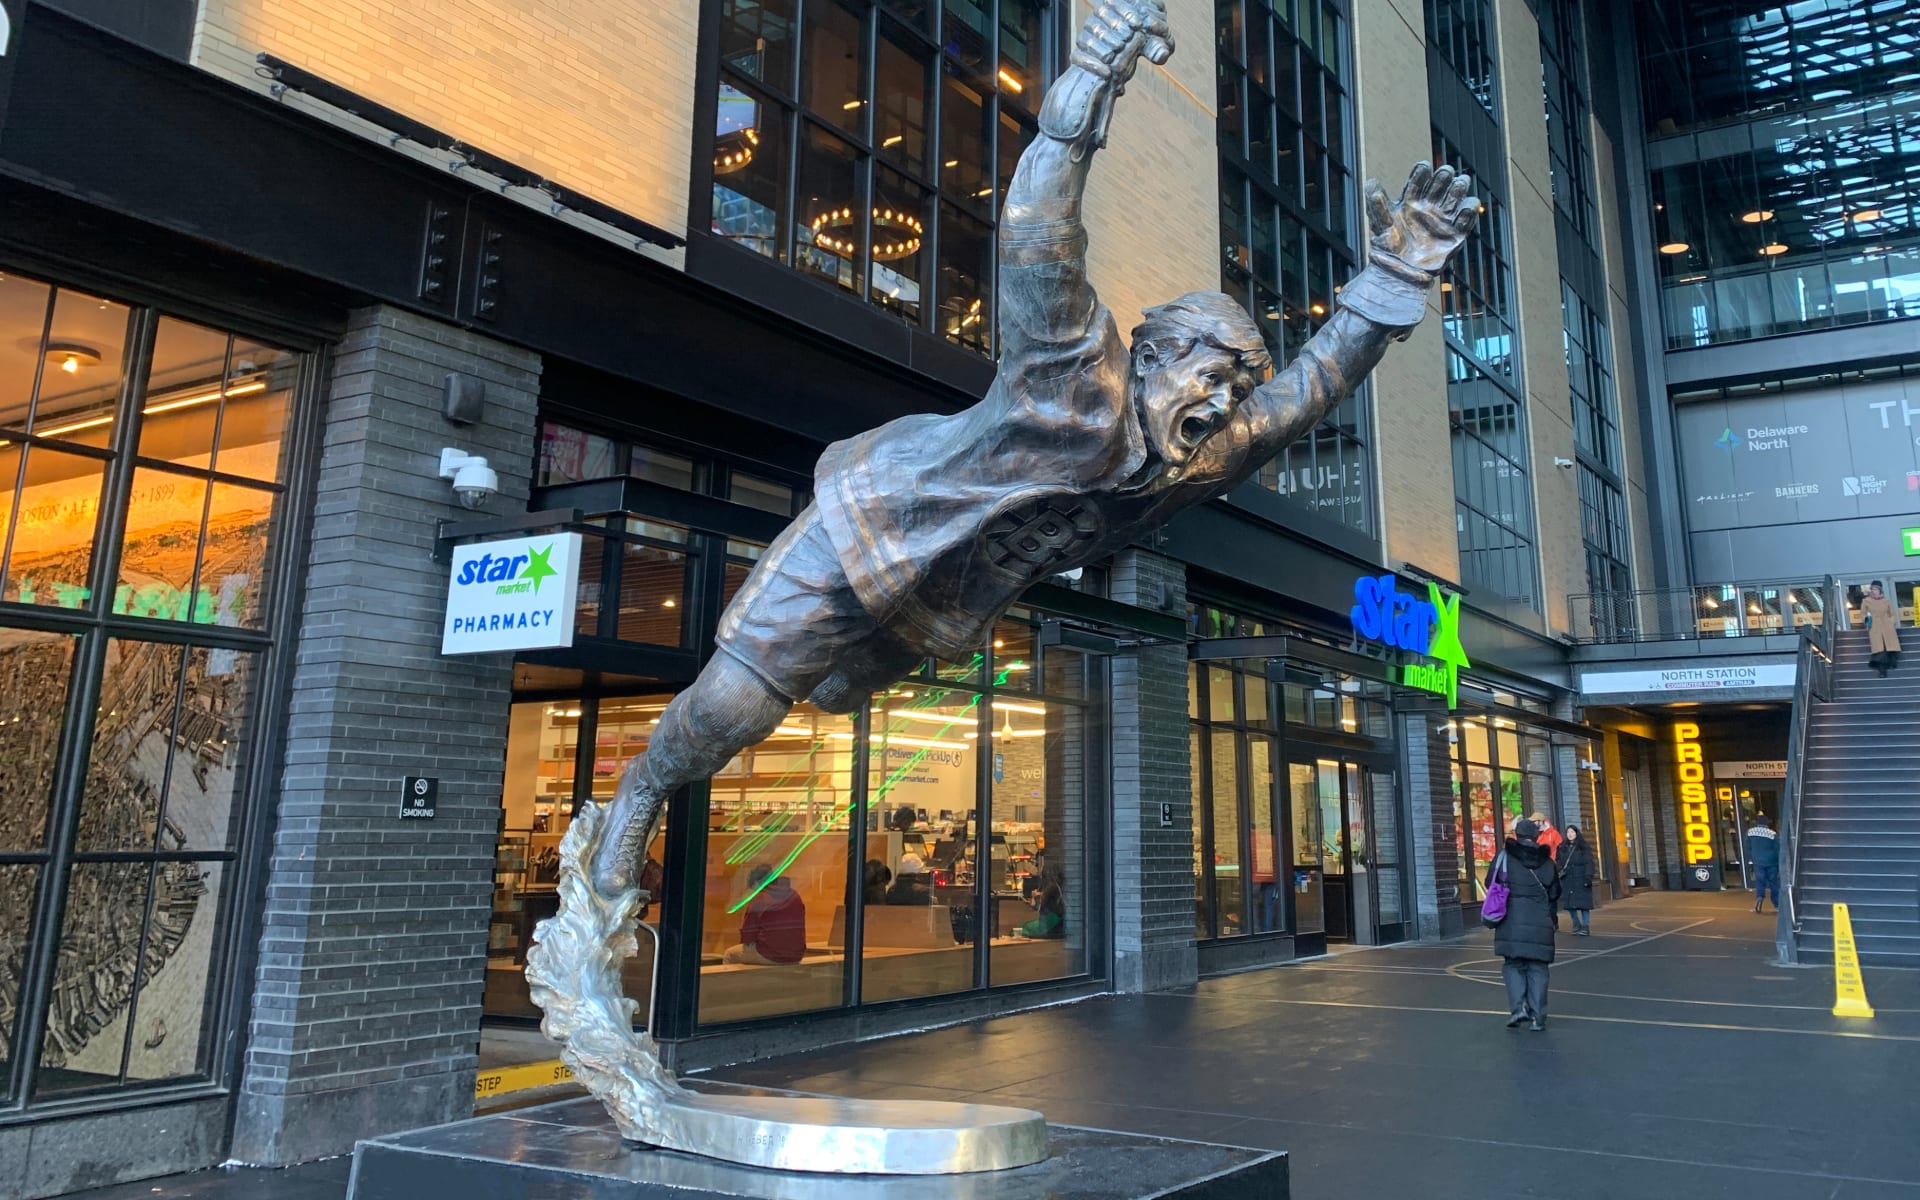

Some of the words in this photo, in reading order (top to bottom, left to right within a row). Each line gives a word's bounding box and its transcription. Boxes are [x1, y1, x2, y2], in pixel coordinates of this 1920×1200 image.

[1747, 425, 1808, 439] Delaware
[1749, 438, 1788, 451] North
[150, 483, 175, 501] 1899
[1775, 484, 1819, 497] BANNERS
[457, 553, 528, 586] star
[496, 581, 531, 595] market
[453, 609, 554, 634] PHARMACY
[1404, 664, 1447, 695] market
[1661, 670, 1703, 681] NORTH
[1706, 667, 1756, 679] STATION
[1674, 723, 1713, 864] PROSHOP
[414, 799, 425, 807] NO
[403, 808, 434, 817] SMOKING
[476, 1077, 502, 1092] STEP
